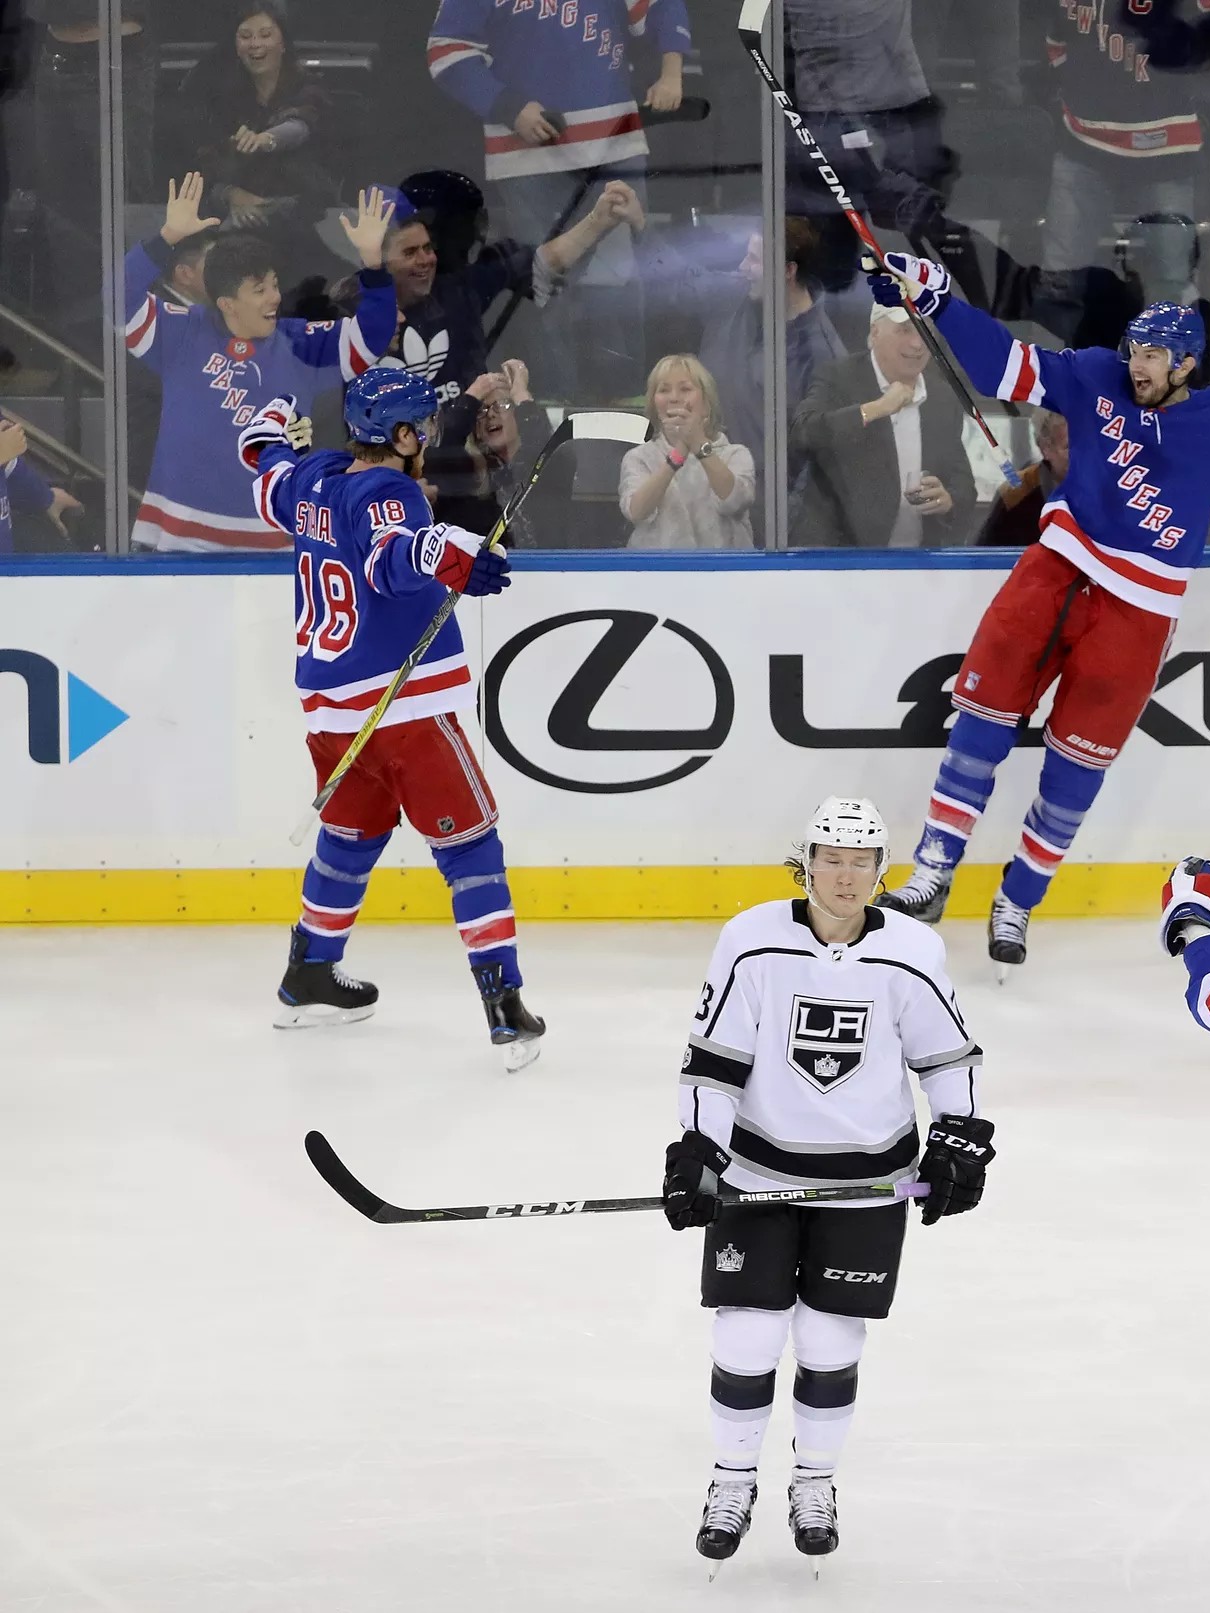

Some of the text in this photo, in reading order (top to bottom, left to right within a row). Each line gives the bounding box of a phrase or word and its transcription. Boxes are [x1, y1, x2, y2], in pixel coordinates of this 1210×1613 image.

[496, 0, 624, 69] ANGERS
[772, 90, 852, 205] EASTON
[1096, 395, 1187, 551] RANGERS
[367, 500, 406, 531] 18
[296, 552, 359, 663] 18
[1066, 733, 1118, 757] BAUER
[694, 981, 715, 1021] 3
[796, 1005, 868, 1039] LA
[929, 1129, 987, 1157] CCM
[485, 1201, 586, 1219] CCM
[823, 1267, 888, 1284] CCM
